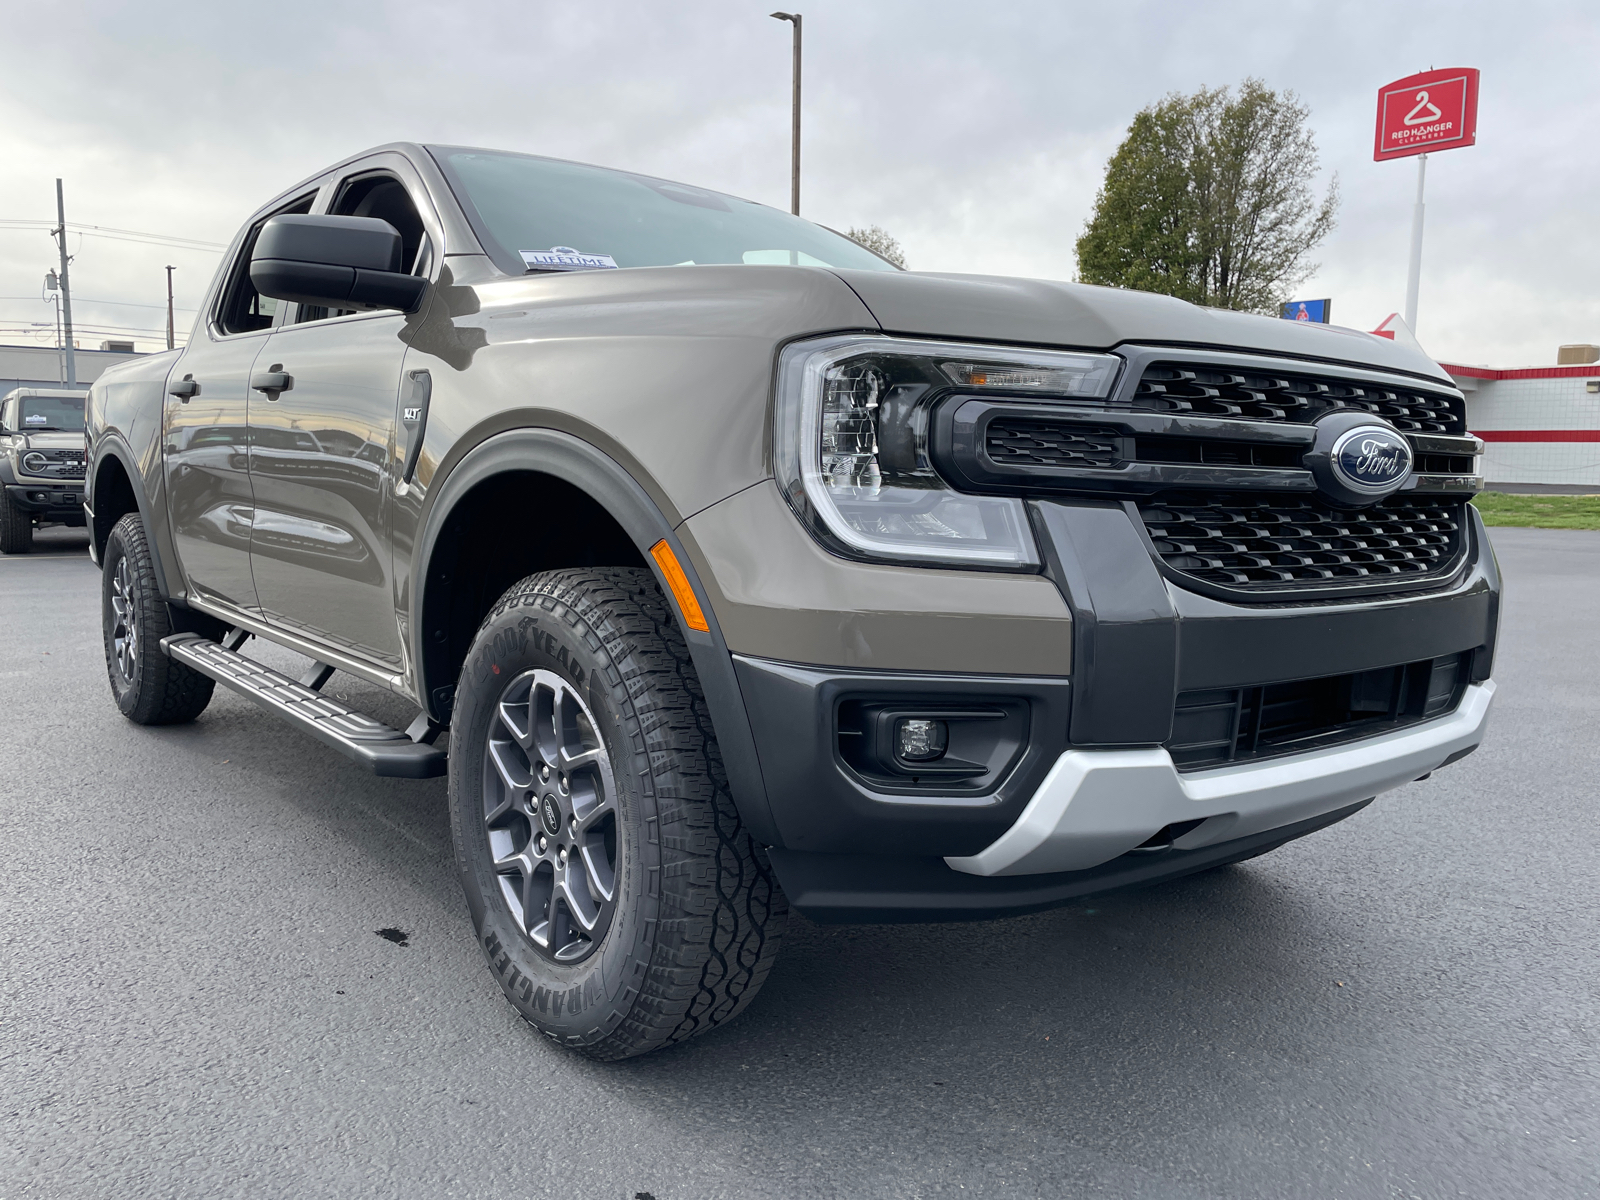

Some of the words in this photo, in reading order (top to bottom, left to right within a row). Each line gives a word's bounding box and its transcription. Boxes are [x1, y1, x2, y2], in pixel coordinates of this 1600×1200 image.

[1392, 130, 1410, 140] RED
[1411, 122, 1453, 136] HANGER
[1399, 132, 1444, 144] CLEANERS
[534, 255, 606, 267] LIFETIME
[404, 407, 422, 420] XLT
[1356, 439, 1399, 476] Ford
[484, 930, 602, 1019] WRANGLER
